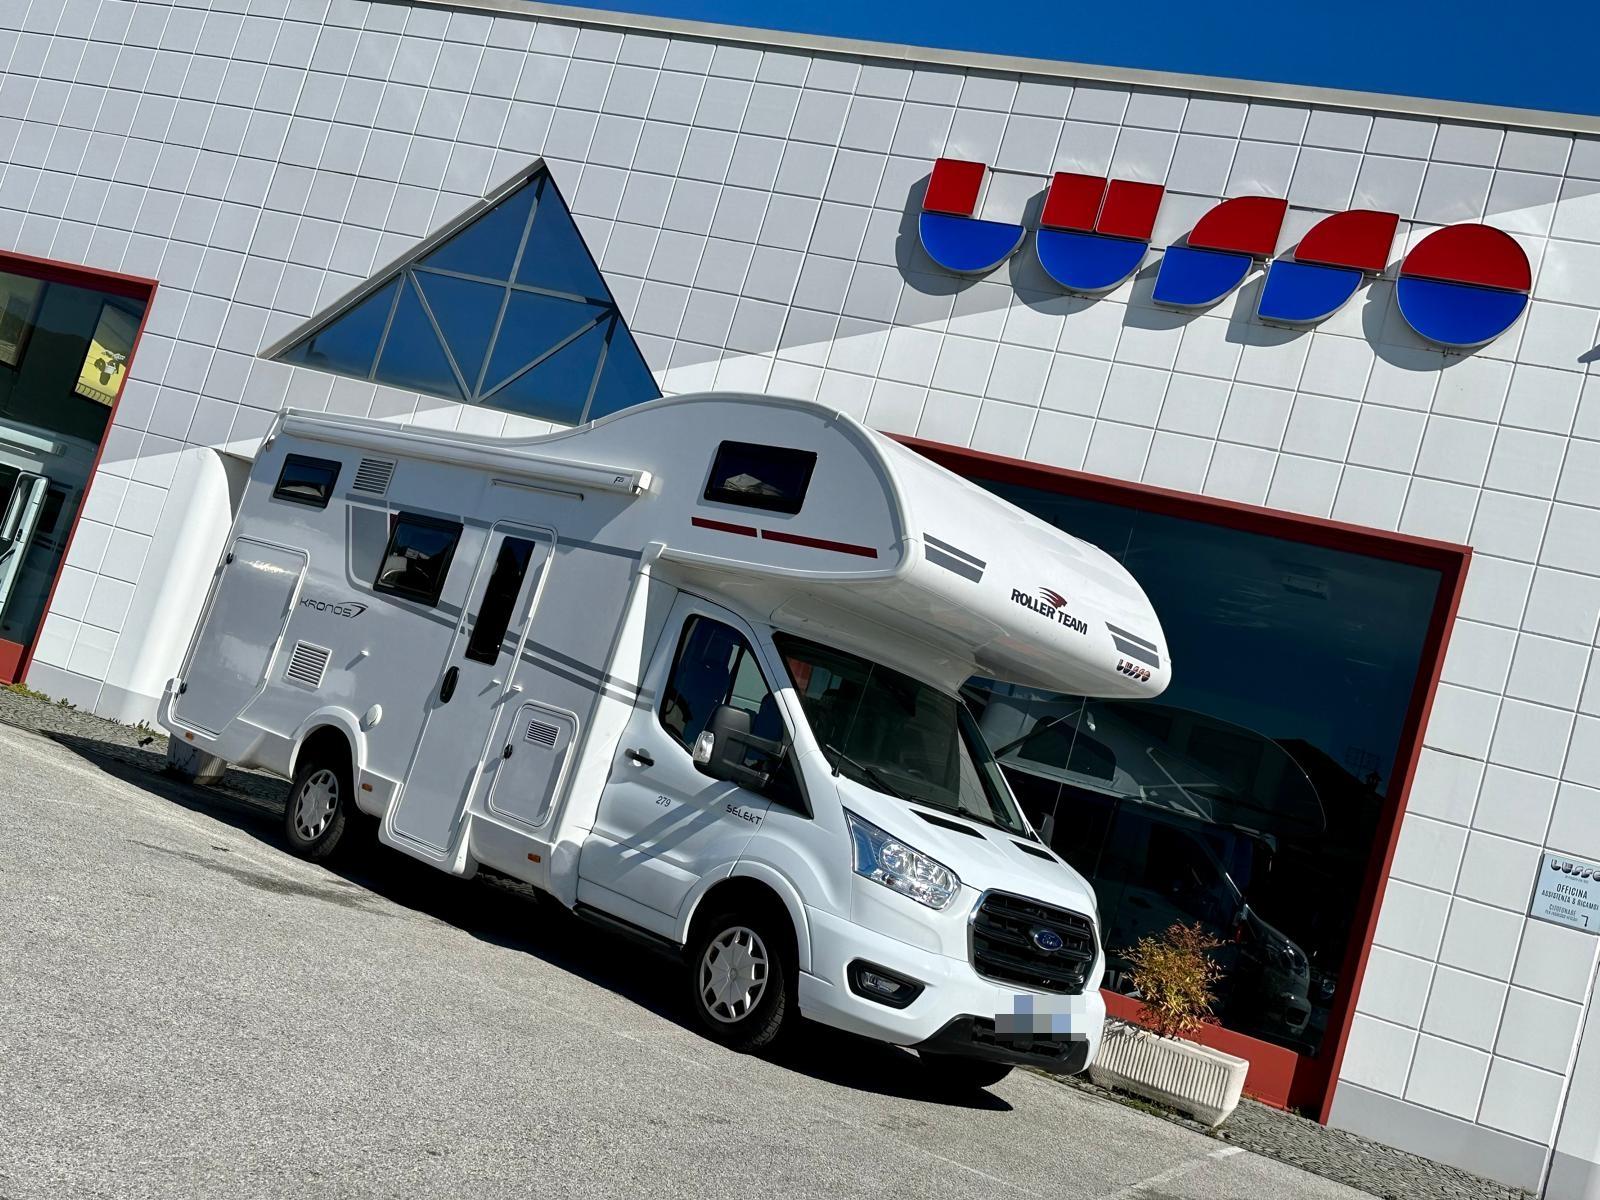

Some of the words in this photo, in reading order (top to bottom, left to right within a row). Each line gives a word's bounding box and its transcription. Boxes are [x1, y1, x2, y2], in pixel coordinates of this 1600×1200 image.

[299, 597, 353, 618] KRONOS
[1010, 588, 1057, 619] ROLLER
[1057, 610, 1089, 635] TEAM
[655, 795, 672, 808] 279
[726, 804, 762, 825] SELEKT
[1541, 889, 1571, 904] ASSISTENZA
[1556, 883, 1588, 899] OFFICINA
